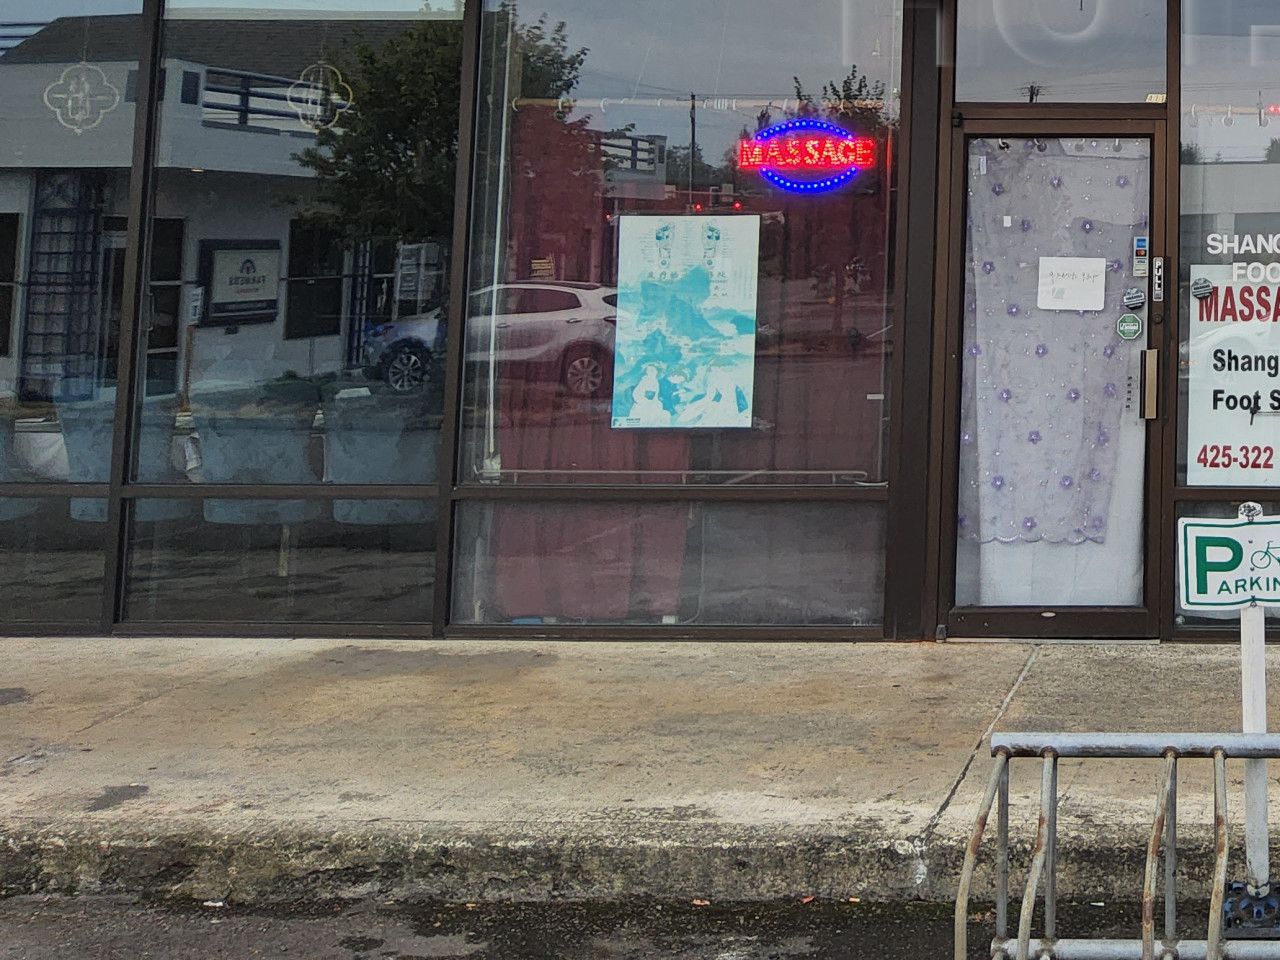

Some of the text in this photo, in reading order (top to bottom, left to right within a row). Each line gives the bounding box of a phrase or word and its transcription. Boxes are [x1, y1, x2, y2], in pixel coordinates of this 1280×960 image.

[740, 139, 874, 166] MASSAGE
[1213, 390, 1261, 410] Foot
[1197, 445, 1274, 468] 425-322
